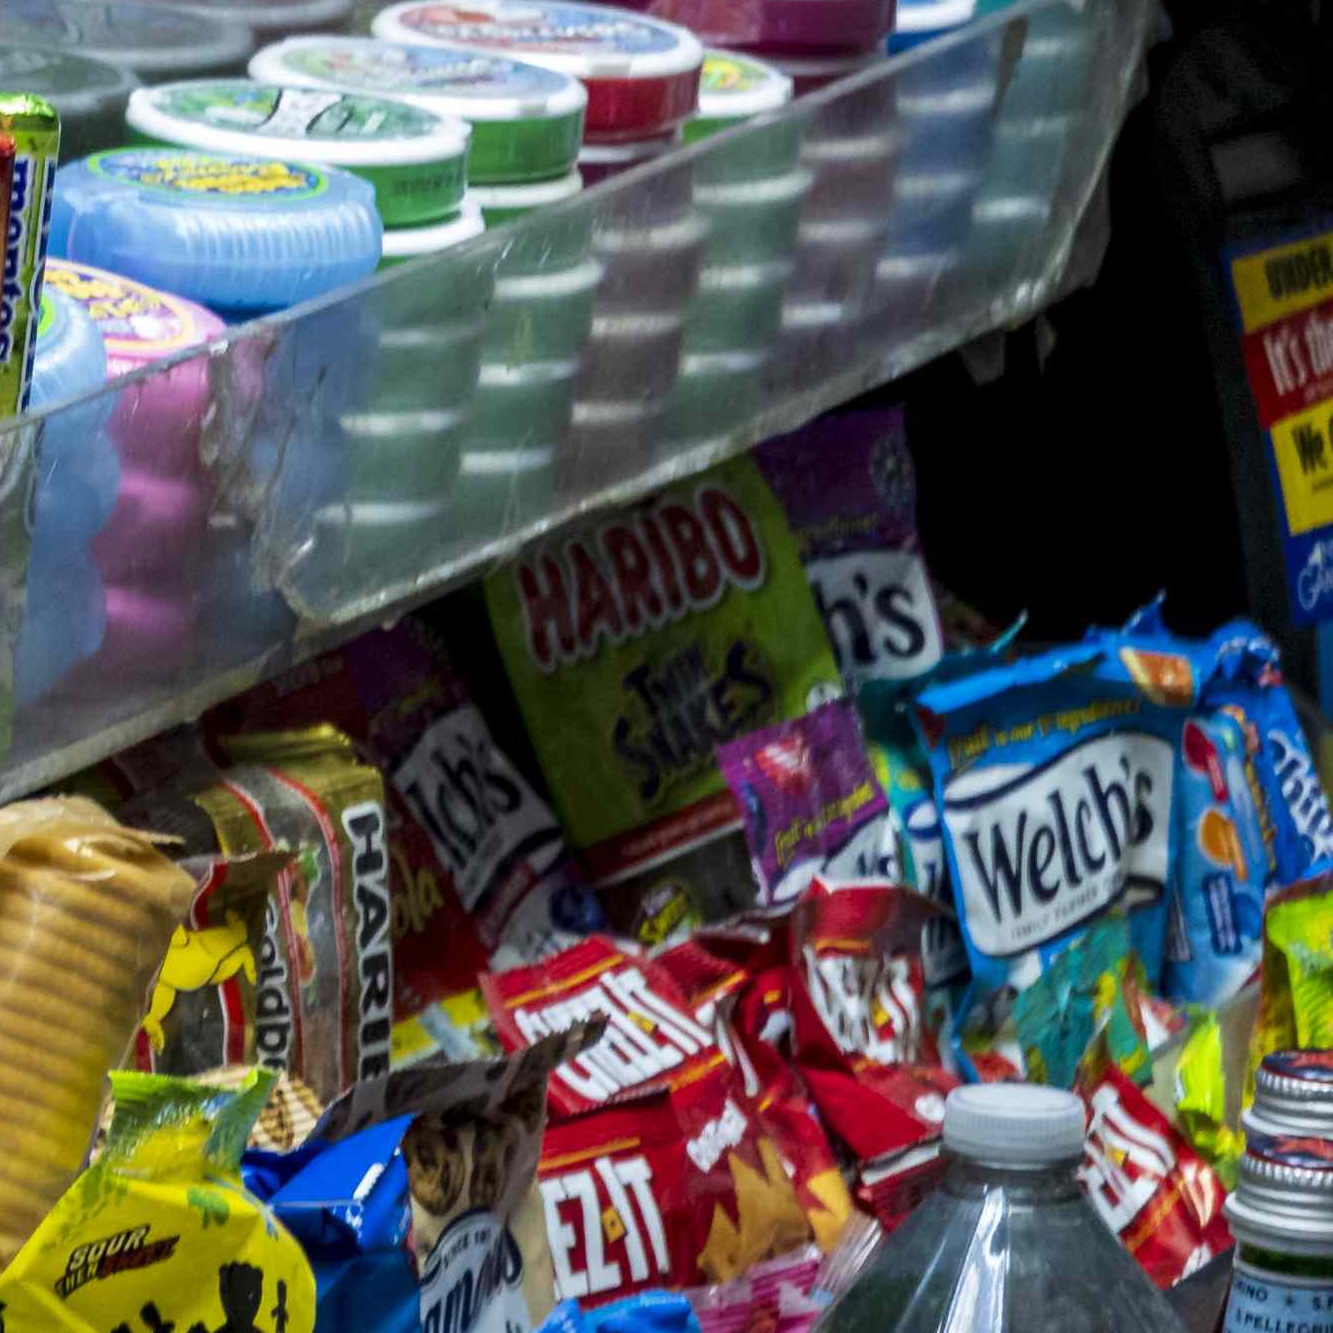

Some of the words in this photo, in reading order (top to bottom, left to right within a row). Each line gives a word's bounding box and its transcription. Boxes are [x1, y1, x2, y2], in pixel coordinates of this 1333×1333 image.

[514, 486, 767, 674] HARIBO
[963, 752, 1155, 926] Welch's
[68, 1224, 151, 1268] SOUR
